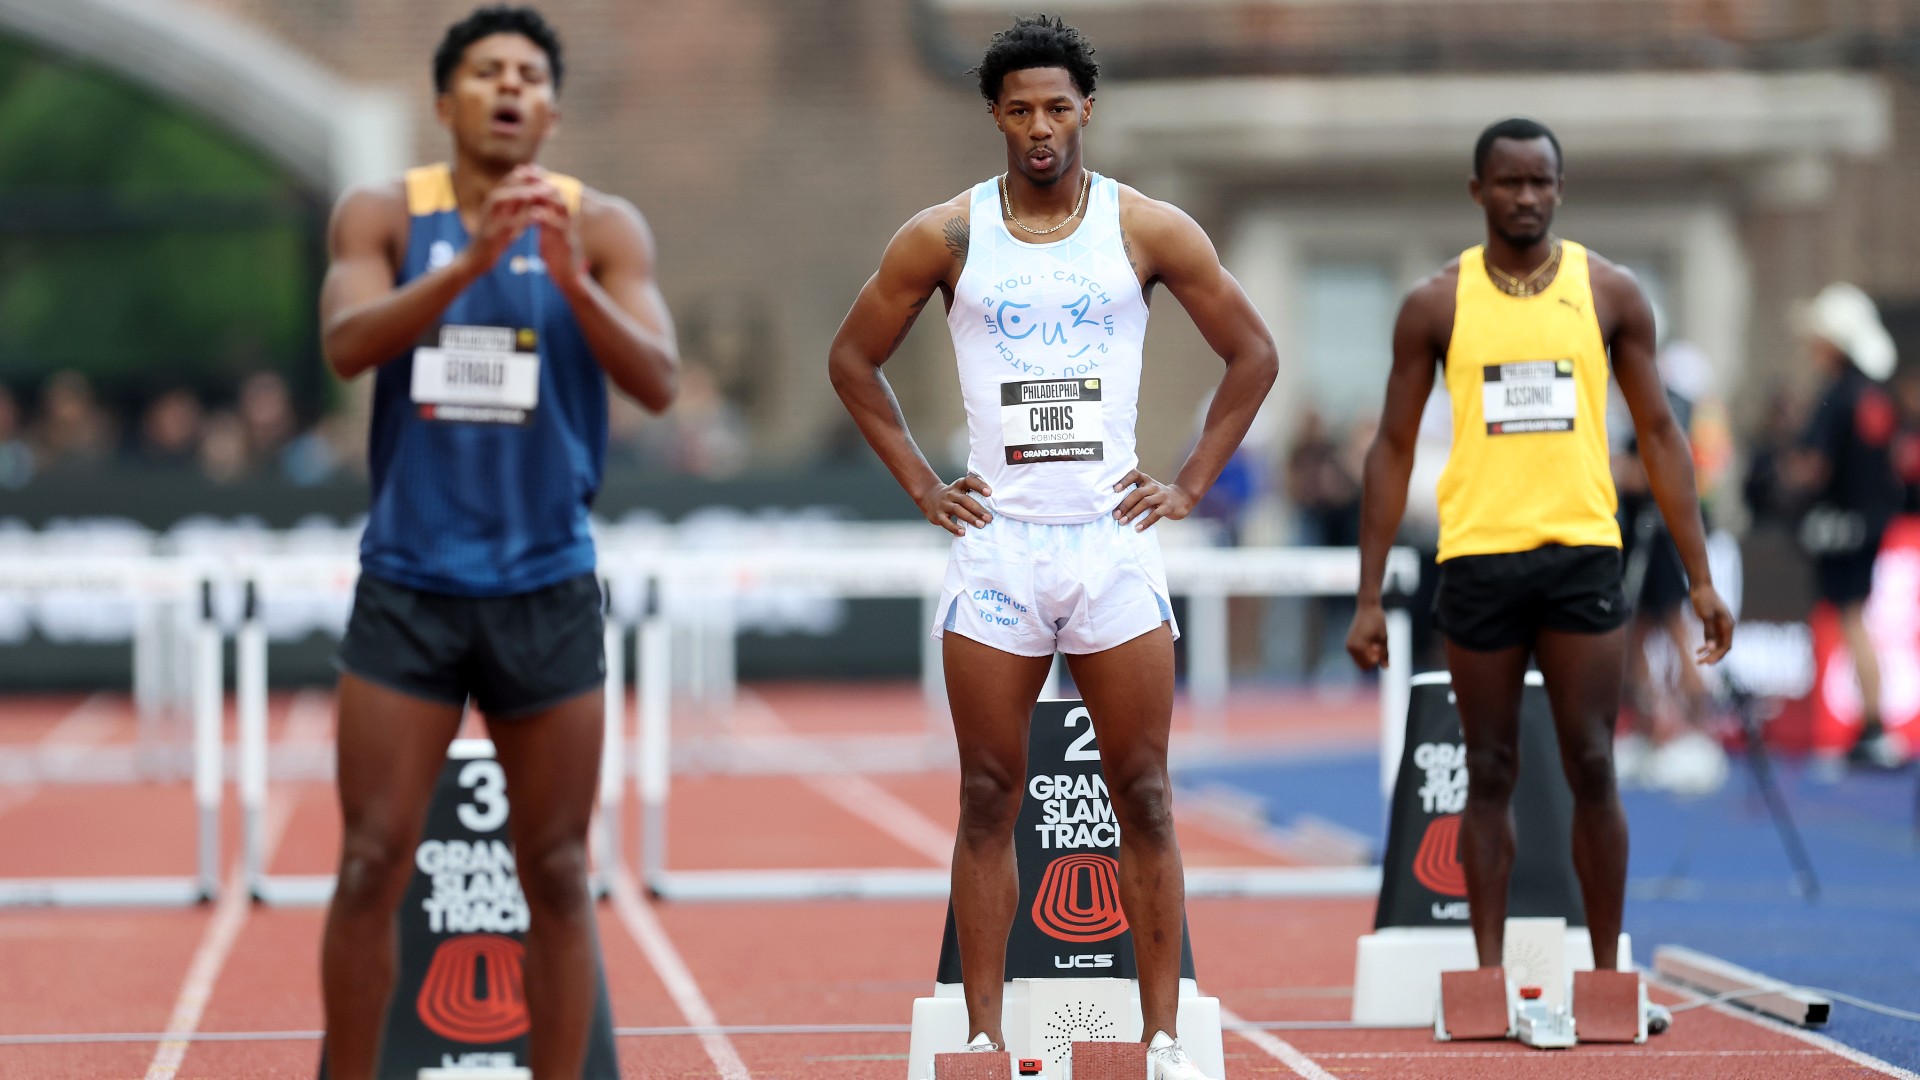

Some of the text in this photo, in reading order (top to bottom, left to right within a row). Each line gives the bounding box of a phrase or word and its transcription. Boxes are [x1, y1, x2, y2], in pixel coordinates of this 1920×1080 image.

[982, 275, 1044, 377] CATCH UP 2 YOU
[1053, 270, 1114, 378] CATCH UP 2 YOU
[1023, 383, 1079, 400] PHILADELPHIA
[1029, 405, 1074, 432] CHRIS
[1031, 432, 1075, 442] ROBINSON
[1023, 447, 1095, 458] GRAND SLAM TRACK
[972, 589, 1011, 605] CATCH
[979, 609, 1019, 626] TO YOU
[1063, 706, 1101, 762] 2
[1413, 742, 1467, 770] GRA
[1029, 773, 1110, 800] GRAN
[1424, 767, 1470, 790] SLA
[456, 759, 510, 833] 3
[1417, 786, 1469, 814] TRA
[1042, 798, 1119, 825] SLAM
[415, 839, 517, 875] GRAN
[1054, 953, 1115, 969] UCS
